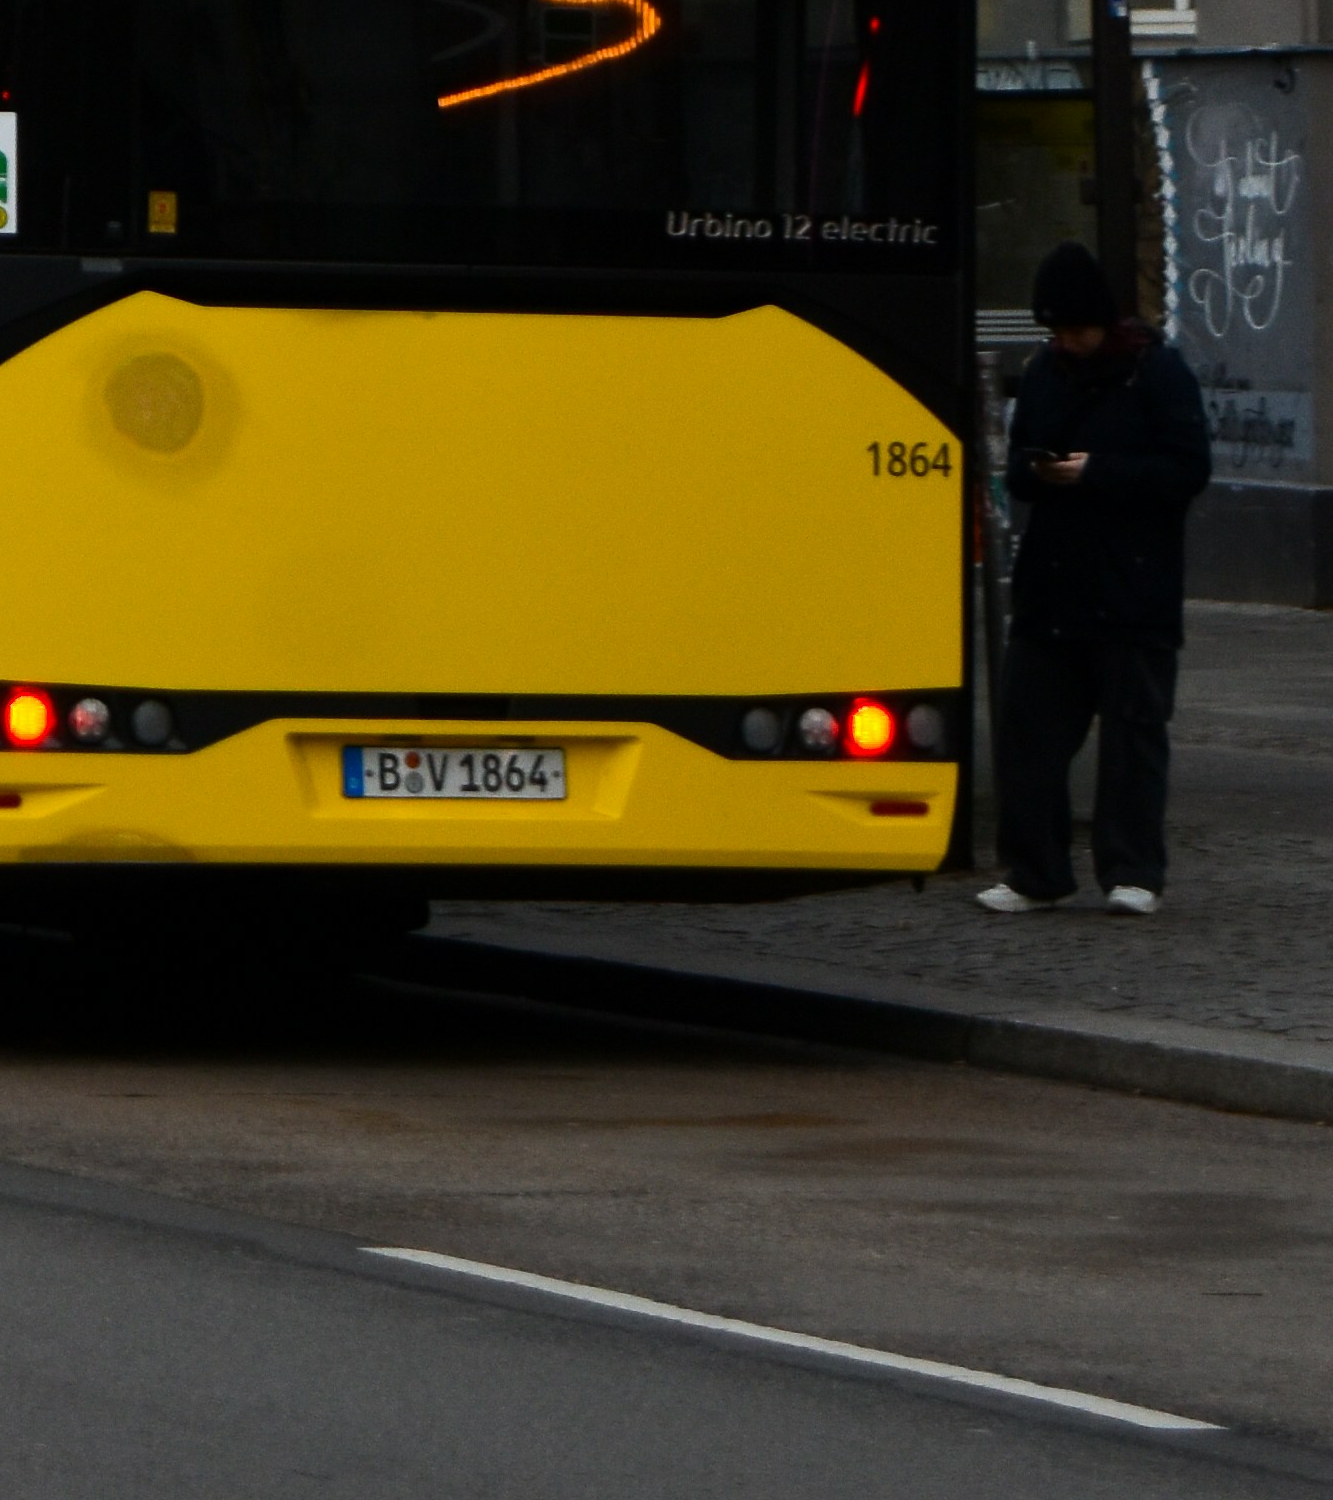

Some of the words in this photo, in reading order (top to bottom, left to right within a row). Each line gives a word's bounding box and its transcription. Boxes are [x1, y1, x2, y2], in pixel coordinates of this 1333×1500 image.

[665, 210, 773, 240] Urbino
[781, 213, 812, 240] 12
[820, 215, 939, 244] electric
[865, 439, 954, 481] 1864
[378, 753, 401, 791] B
[426, 753, 448, 791] V
[460, 753, 548, 792] 1864
